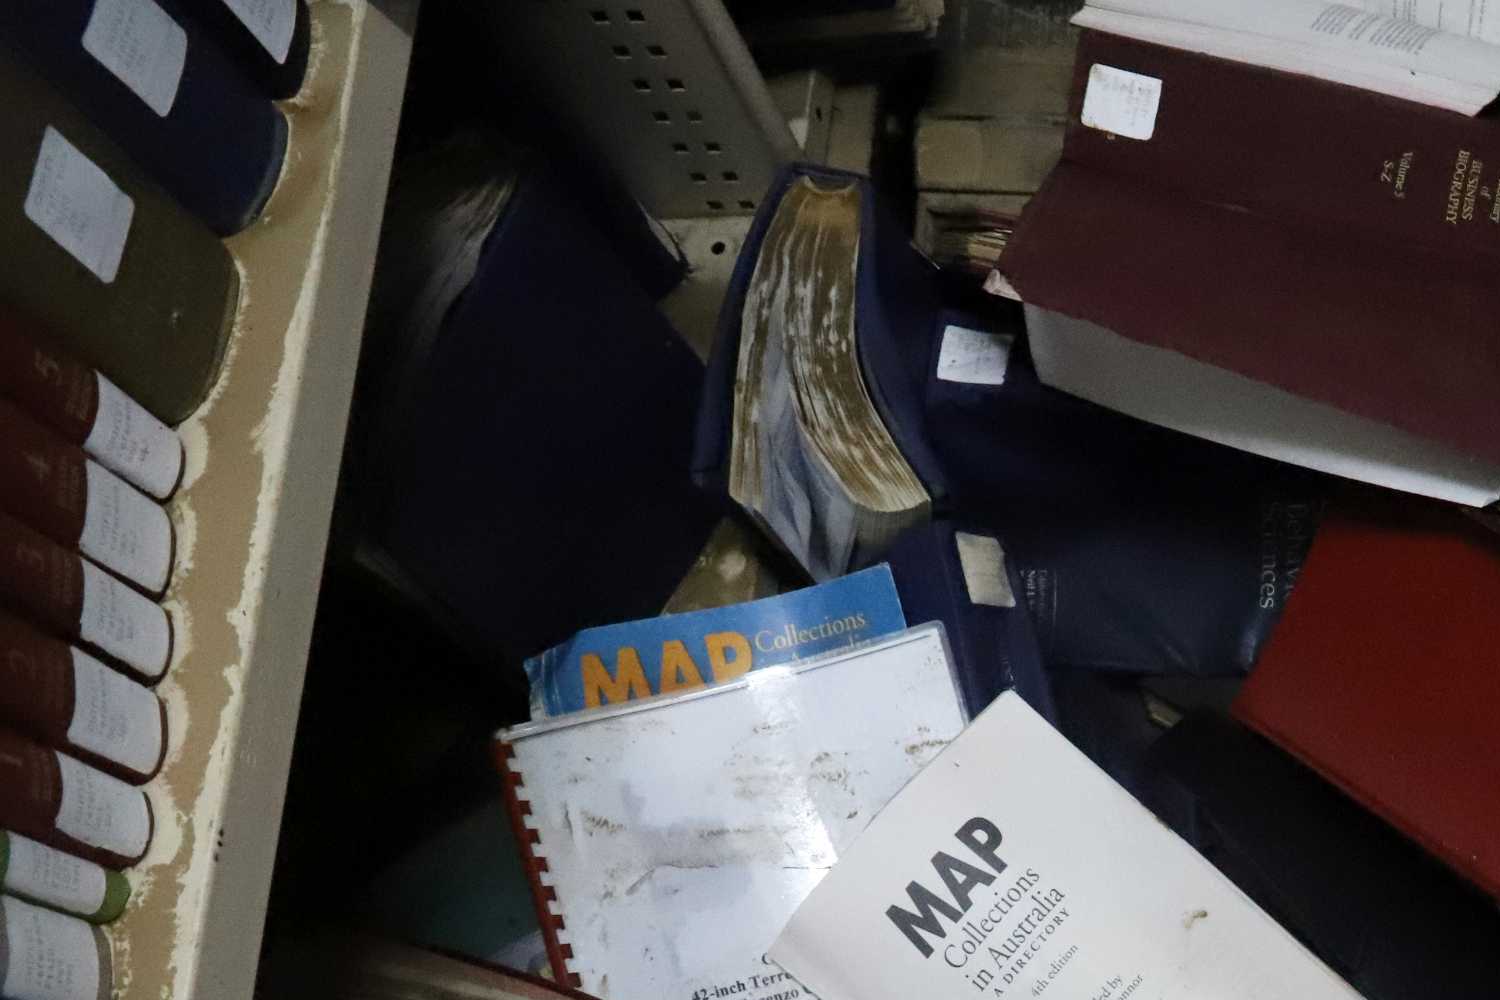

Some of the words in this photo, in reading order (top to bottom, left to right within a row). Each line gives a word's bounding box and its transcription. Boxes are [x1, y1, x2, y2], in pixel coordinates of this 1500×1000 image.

[1380, 160, 1394, 184] S-Z
[1394, 152, 1414, 192] Volume
[1446, 150, 1470, 225] BIOGRAPHY
[1460, 160, 1483, 222] BUSINESS
[1259, 503, 1280, 608] Sciences
[755, 610, 867, 653] Collections
[581, 628, 754, 711] MAP
[885, 813, 1008, 959] MAP
[947, 869, 1040, 969] Collections
[965, 969, 994, 993] in
[987, 891, 1066, 971] Australia
[993, 988, 1005, 998] A
[1001, 908, 1072, 985] DIRECTORY
[1028, 980, 1048, 998] 4th
[1042, 944, 1079, 983] edition
[1105, 974, 1124, 992] by
